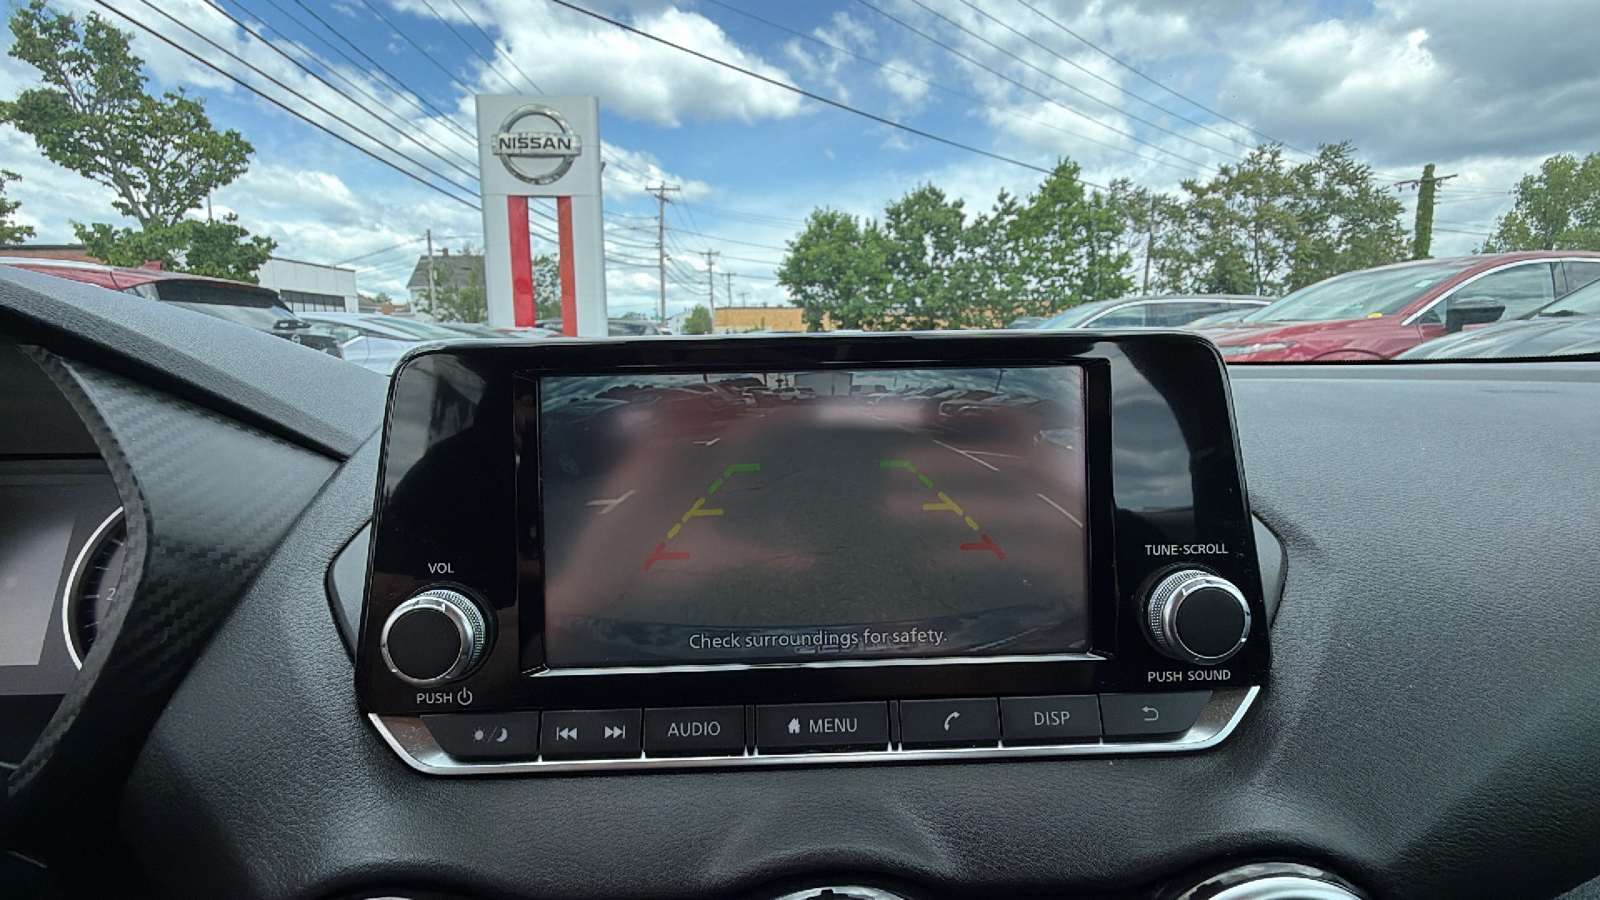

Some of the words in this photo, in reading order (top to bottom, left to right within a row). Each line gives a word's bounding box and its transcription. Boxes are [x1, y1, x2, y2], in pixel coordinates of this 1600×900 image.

[499, 136, 572, 151] NISSAN
[427, 561, 455, 575] VOL
[689, 633, 741, 650] Check
[745, 630, 859, 647] surroundings
[862, 628, 890, 645] for
[892, 626, 949, 645] safety.
[1146, 671, 1183, 684] PUSH
[1187, 669, 1232, 682] SOUND
[415, 692, 453, 705] PUSH
[808, 717, 859, 734] MENU
[1033, 711, 1071, 727] DISP
[666, 721, 722, 738] AUDIO
